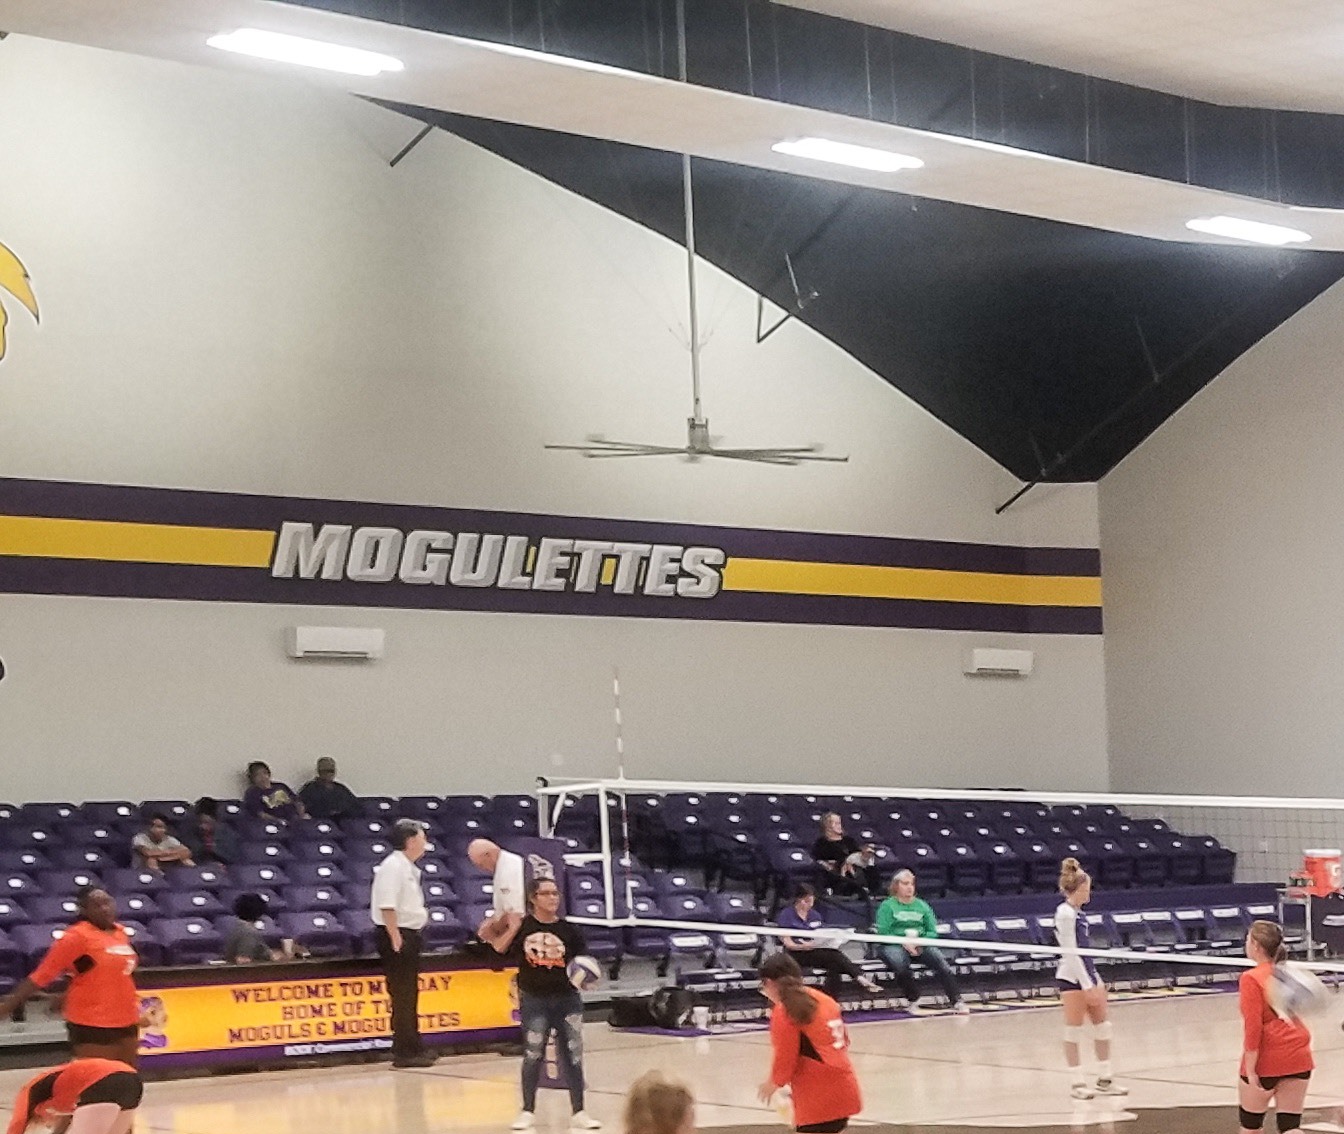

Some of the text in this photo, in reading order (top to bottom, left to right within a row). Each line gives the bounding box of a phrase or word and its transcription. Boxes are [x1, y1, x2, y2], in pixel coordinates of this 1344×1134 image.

[271, 520, 725, 599] MOGULETTES
[231, 983, 334, 1004] WELCOME
[339, 981, 363, 997] TO
[342, 1000, 365, 1017] OF
[228, 1022, 311, 1043] MOGULS
